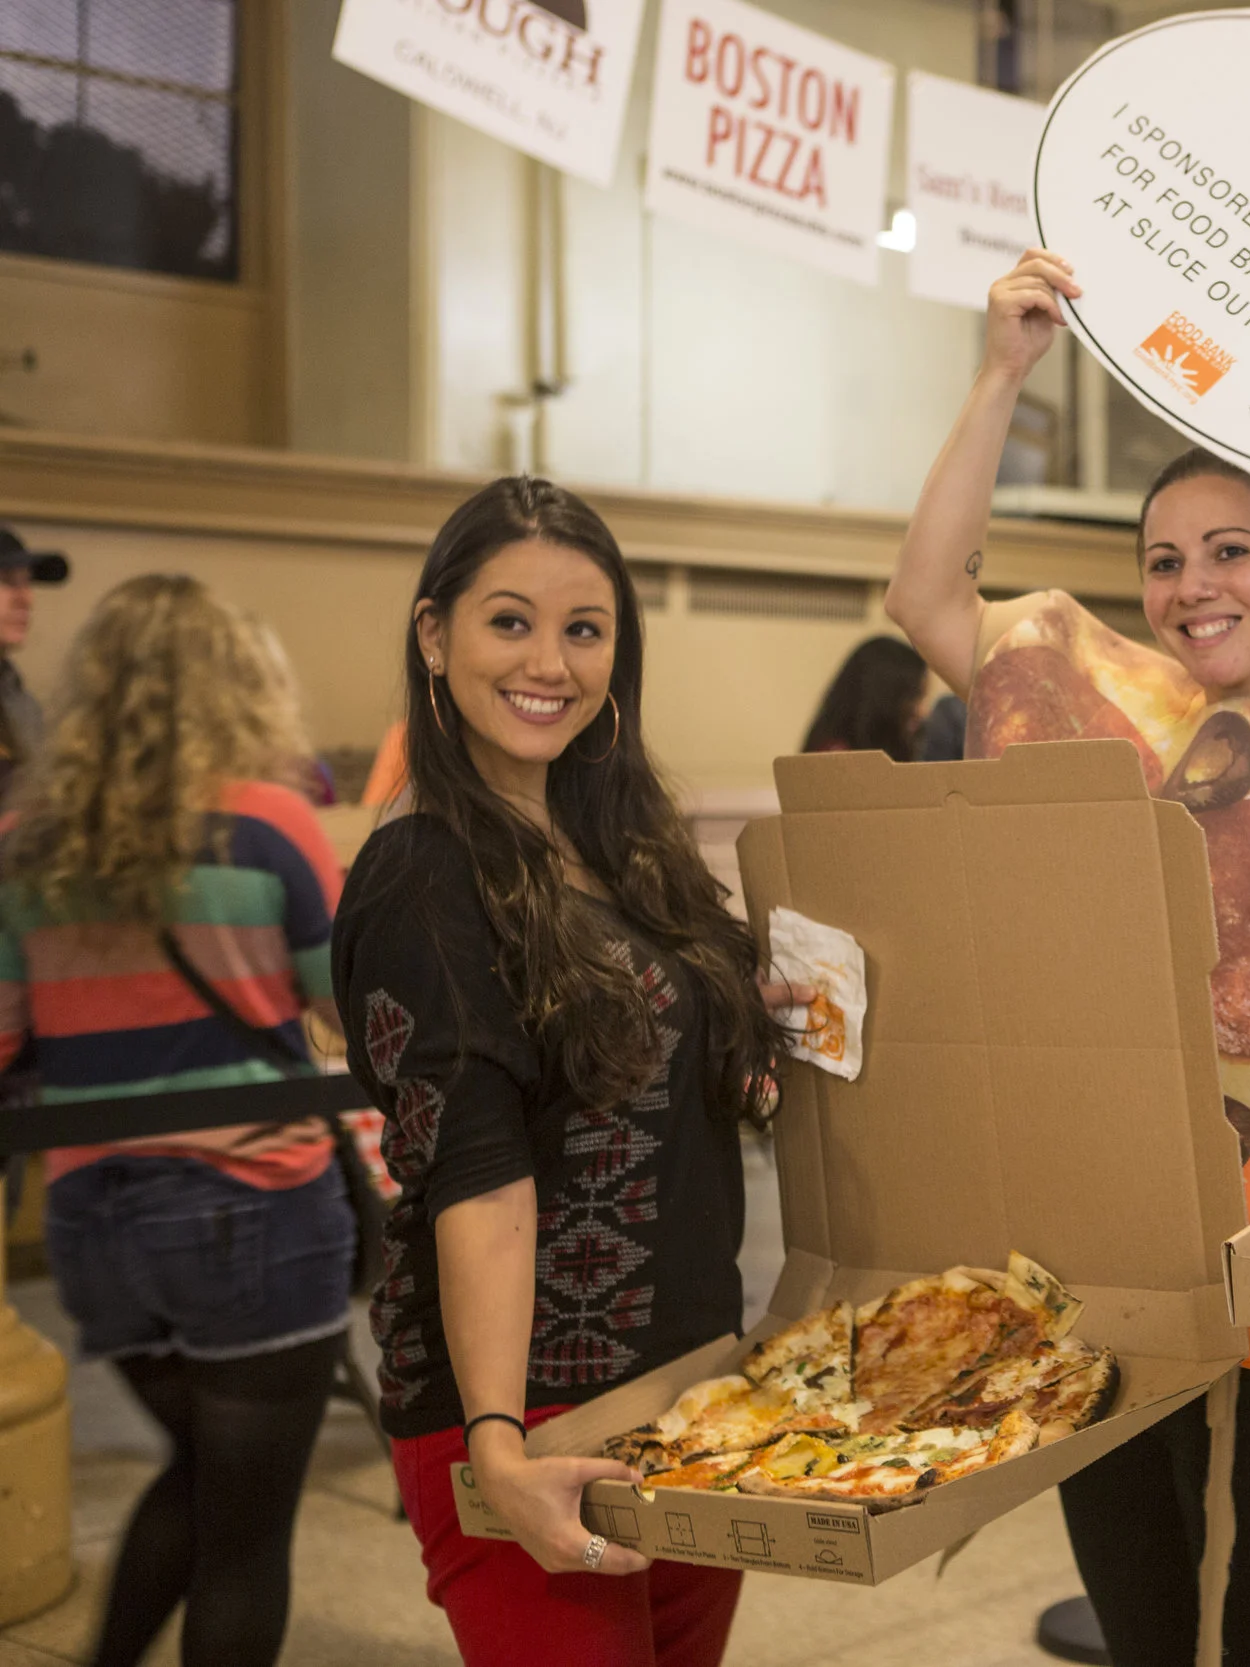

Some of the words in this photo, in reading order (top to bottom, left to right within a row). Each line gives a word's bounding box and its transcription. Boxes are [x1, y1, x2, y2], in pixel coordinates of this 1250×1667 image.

[684, 17, 861, 145] BOSTON
[1112, 102, 1129, 119] I
[705, 104, 828, 209] PIZZA
[1100, 143, 1156, 192] FOR
[1155, 187, 1229, 249] FOOD
[1093, 191, 1133, 218] AT
[1129, 217, 1208, 283] SLICE
[1165, 310, 1204, 342] FOOD
[1202, 337, 1238, 370] BANK
[810, 1516, 831, 1526] MADE
[831, 1518, 840, 1527] IN
[841, 1520, 857, 1530] USA
